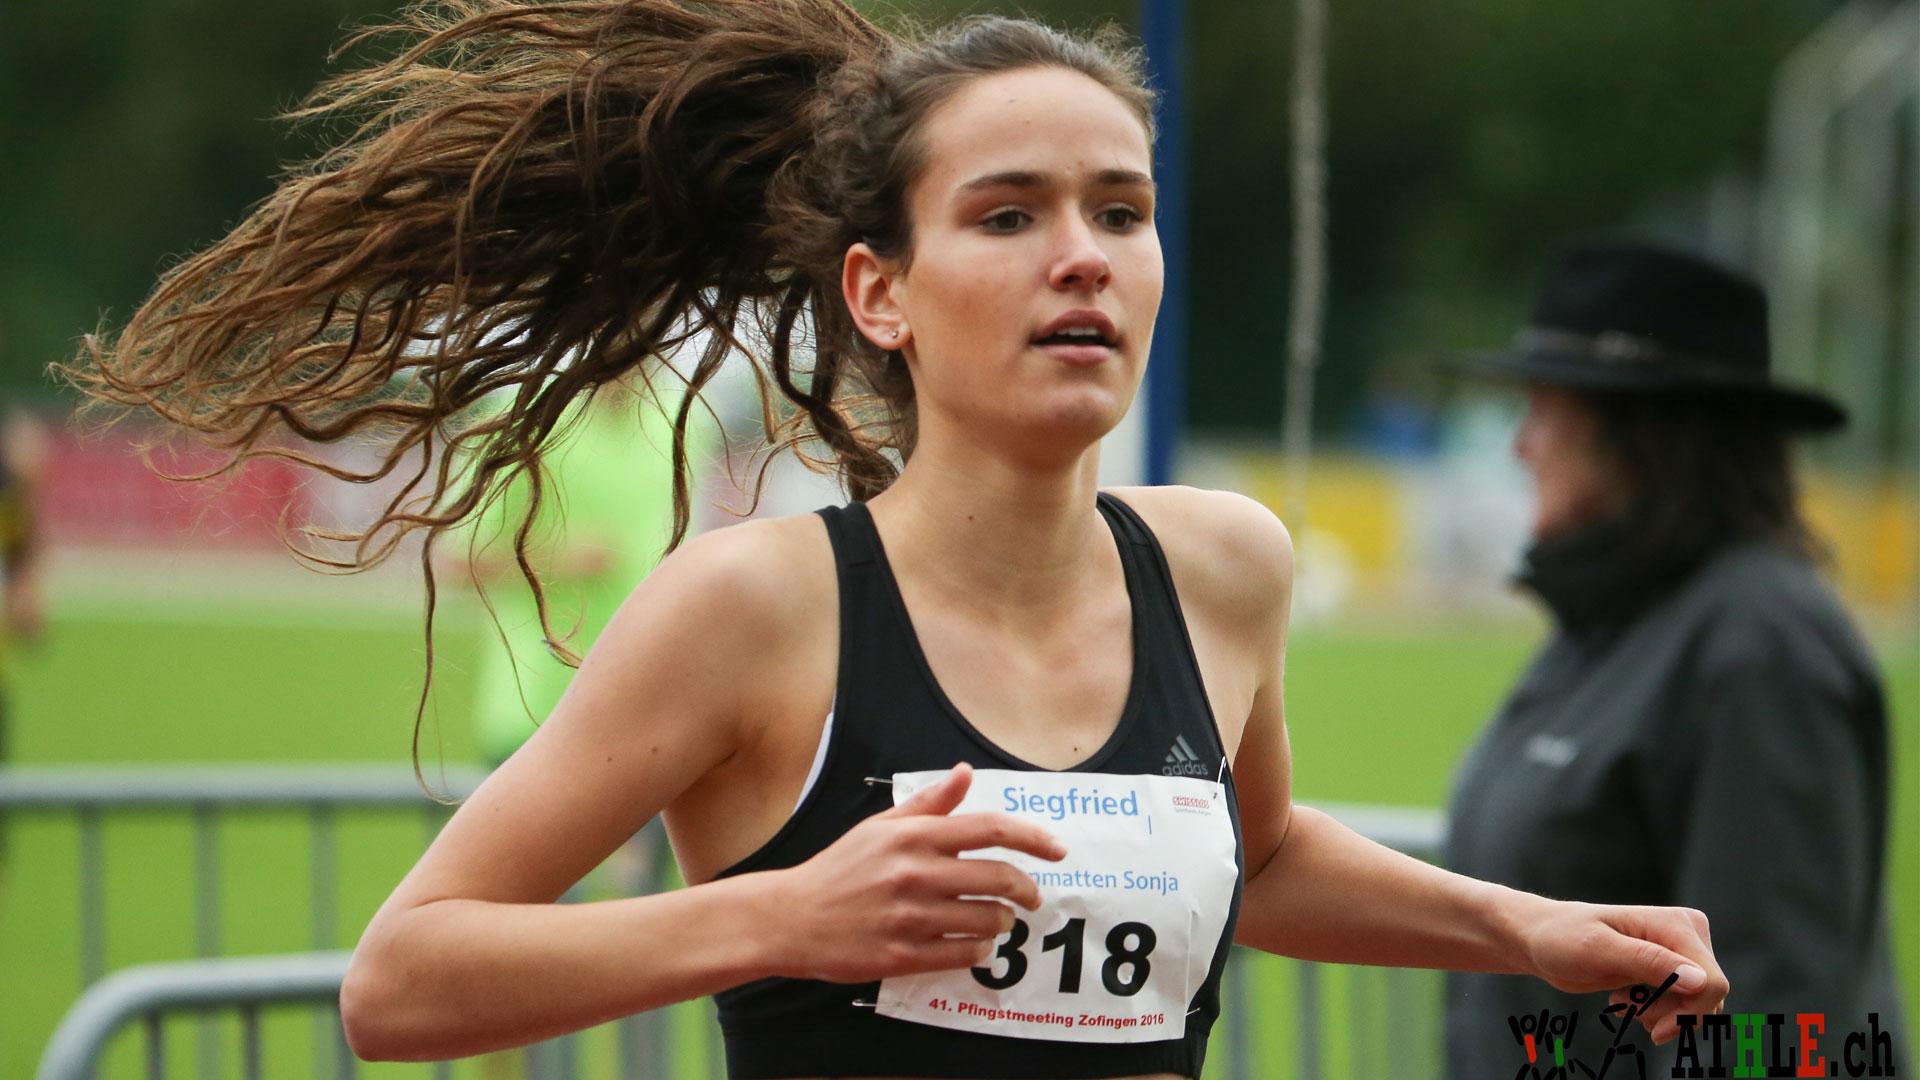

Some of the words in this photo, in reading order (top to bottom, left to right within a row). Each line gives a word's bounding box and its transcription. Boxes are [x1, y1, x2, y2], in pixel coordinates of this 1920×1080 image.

[1162, 759, 1209, 776] adidas
[1003, 787, 1139, 820] Siegfried
[1123, 870, 1178, 896] Sonja
[970, 917, 1157, 997] 318
[929, 998, 952, 1012] 41.
[957, 1001, 1074, 1027] Pfingstmeeting
[1078, 1014, 1137, 1029] Zofingen
[1140, 1013, 1164, 1026] 2016
